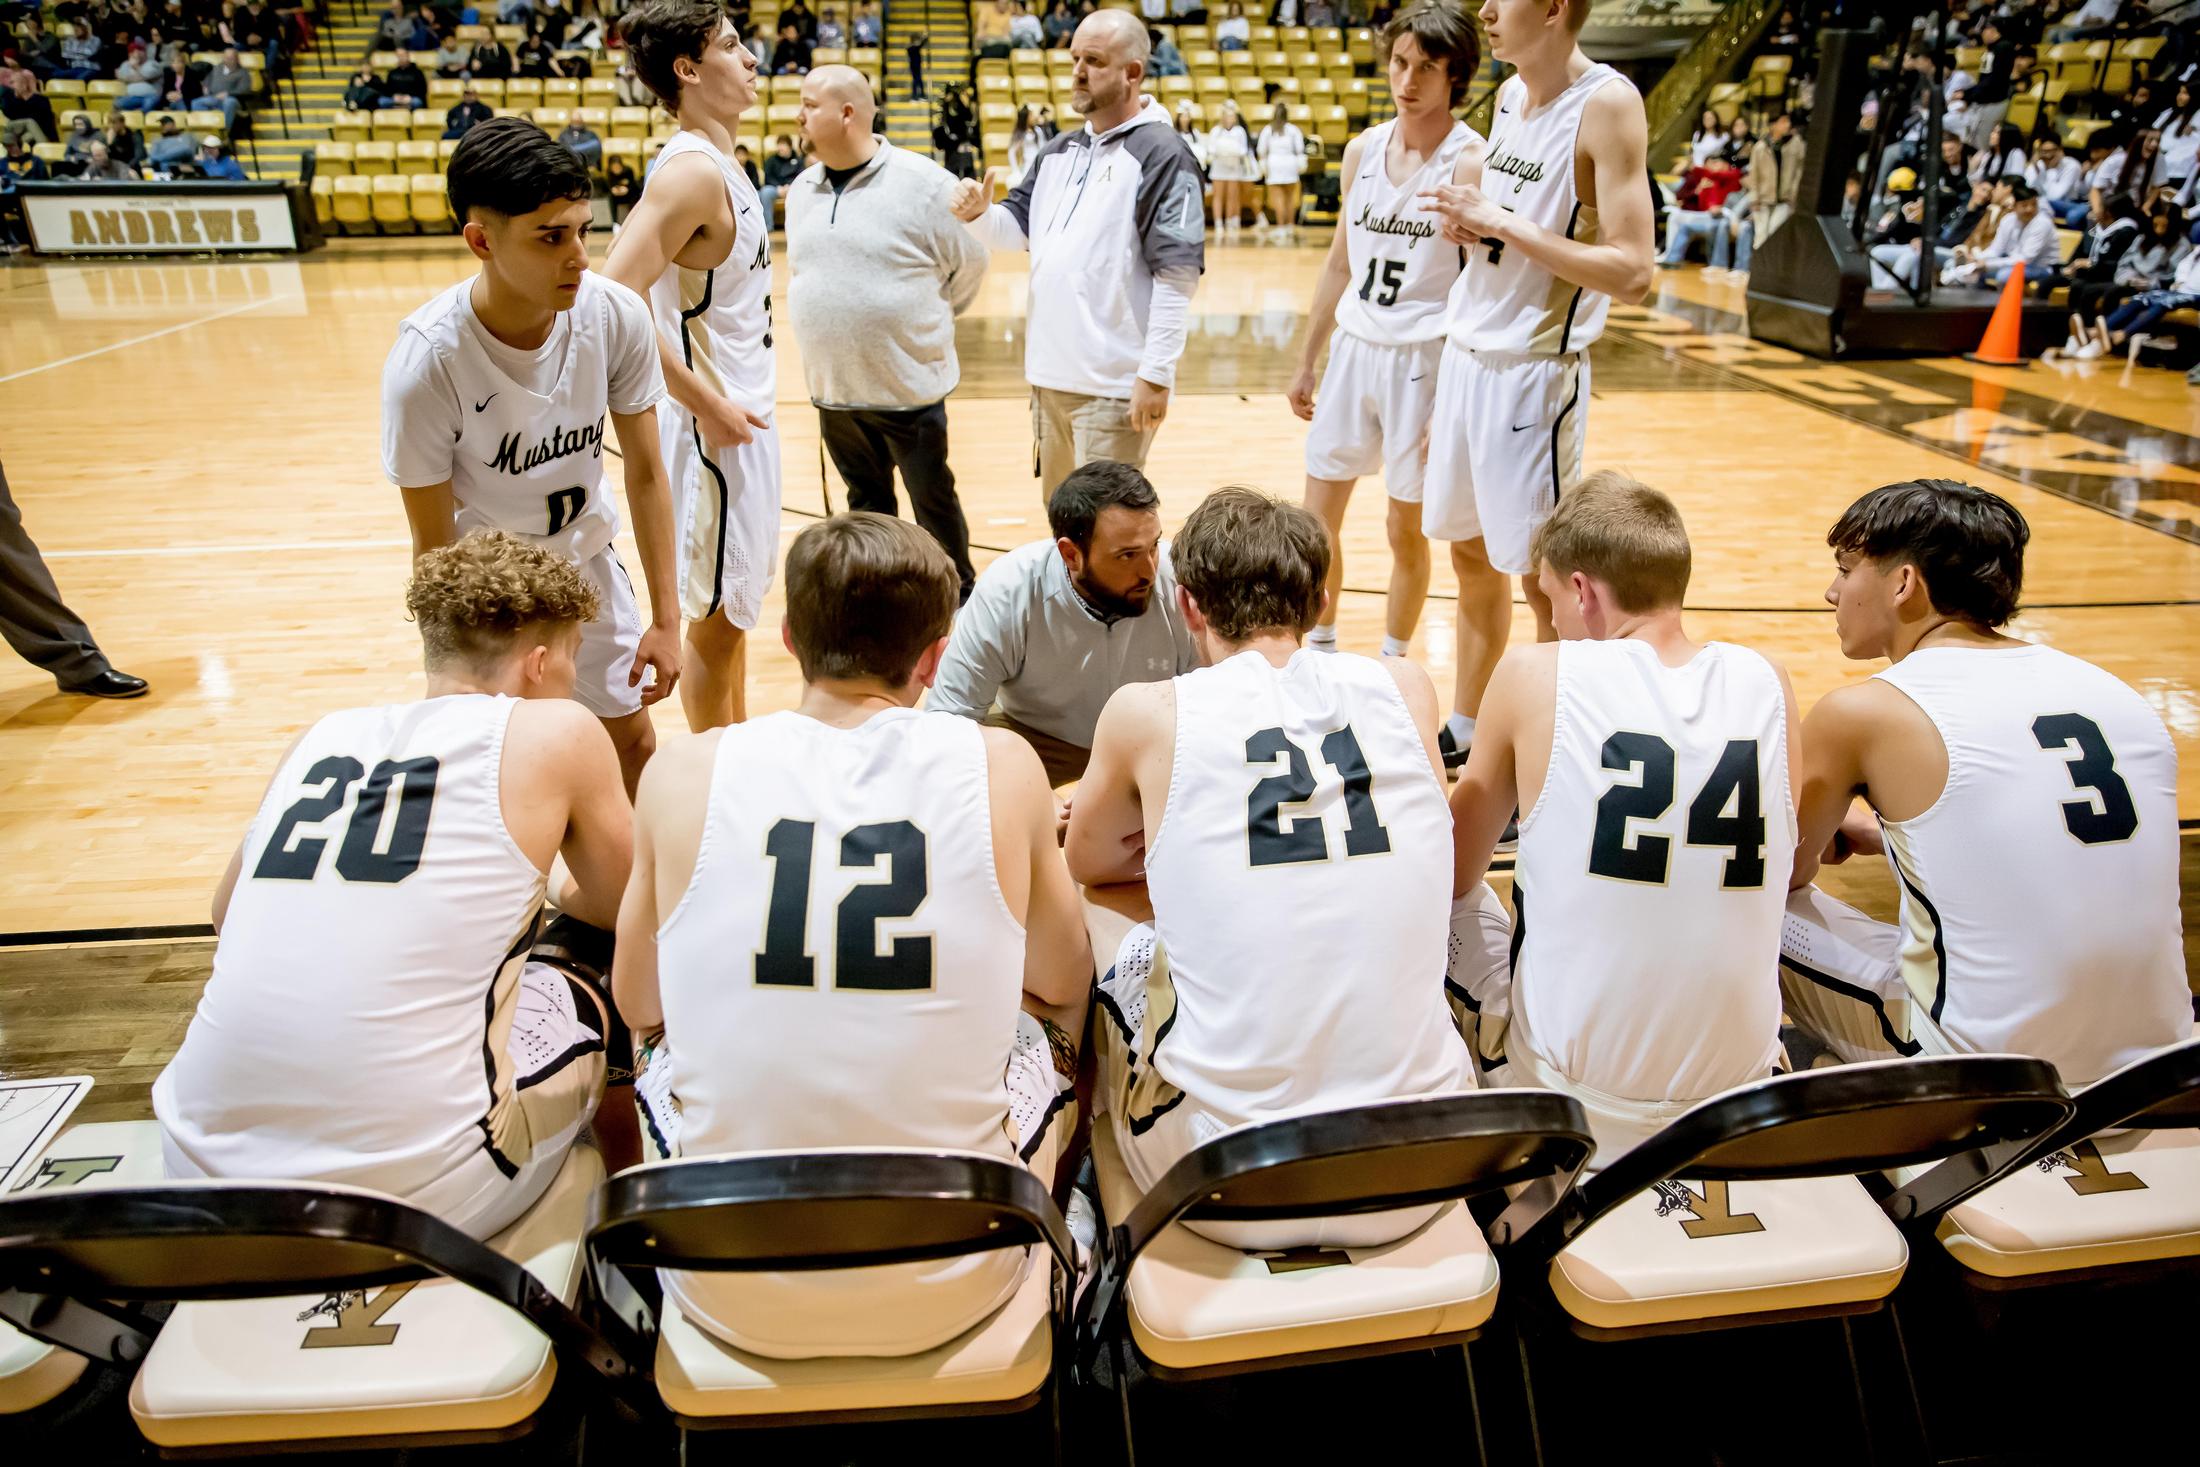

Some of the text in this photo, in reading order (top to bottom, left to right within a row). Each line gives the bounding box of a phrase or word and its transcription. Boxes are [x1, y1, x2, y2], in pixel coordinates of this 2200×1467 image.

[69, 209, 261, 244] ANDREWS
[1354, 202, 1436, 249] Mustangs
[1359, 258, 1407, 307] 15
[252, 754, 442, 884] 20
[1244, 721, 1393, 868] 21
[1586, 730, 1768, 891] 24
[2031, 712, 2139, 846] 3
[752, 817, 936, 994] 12
